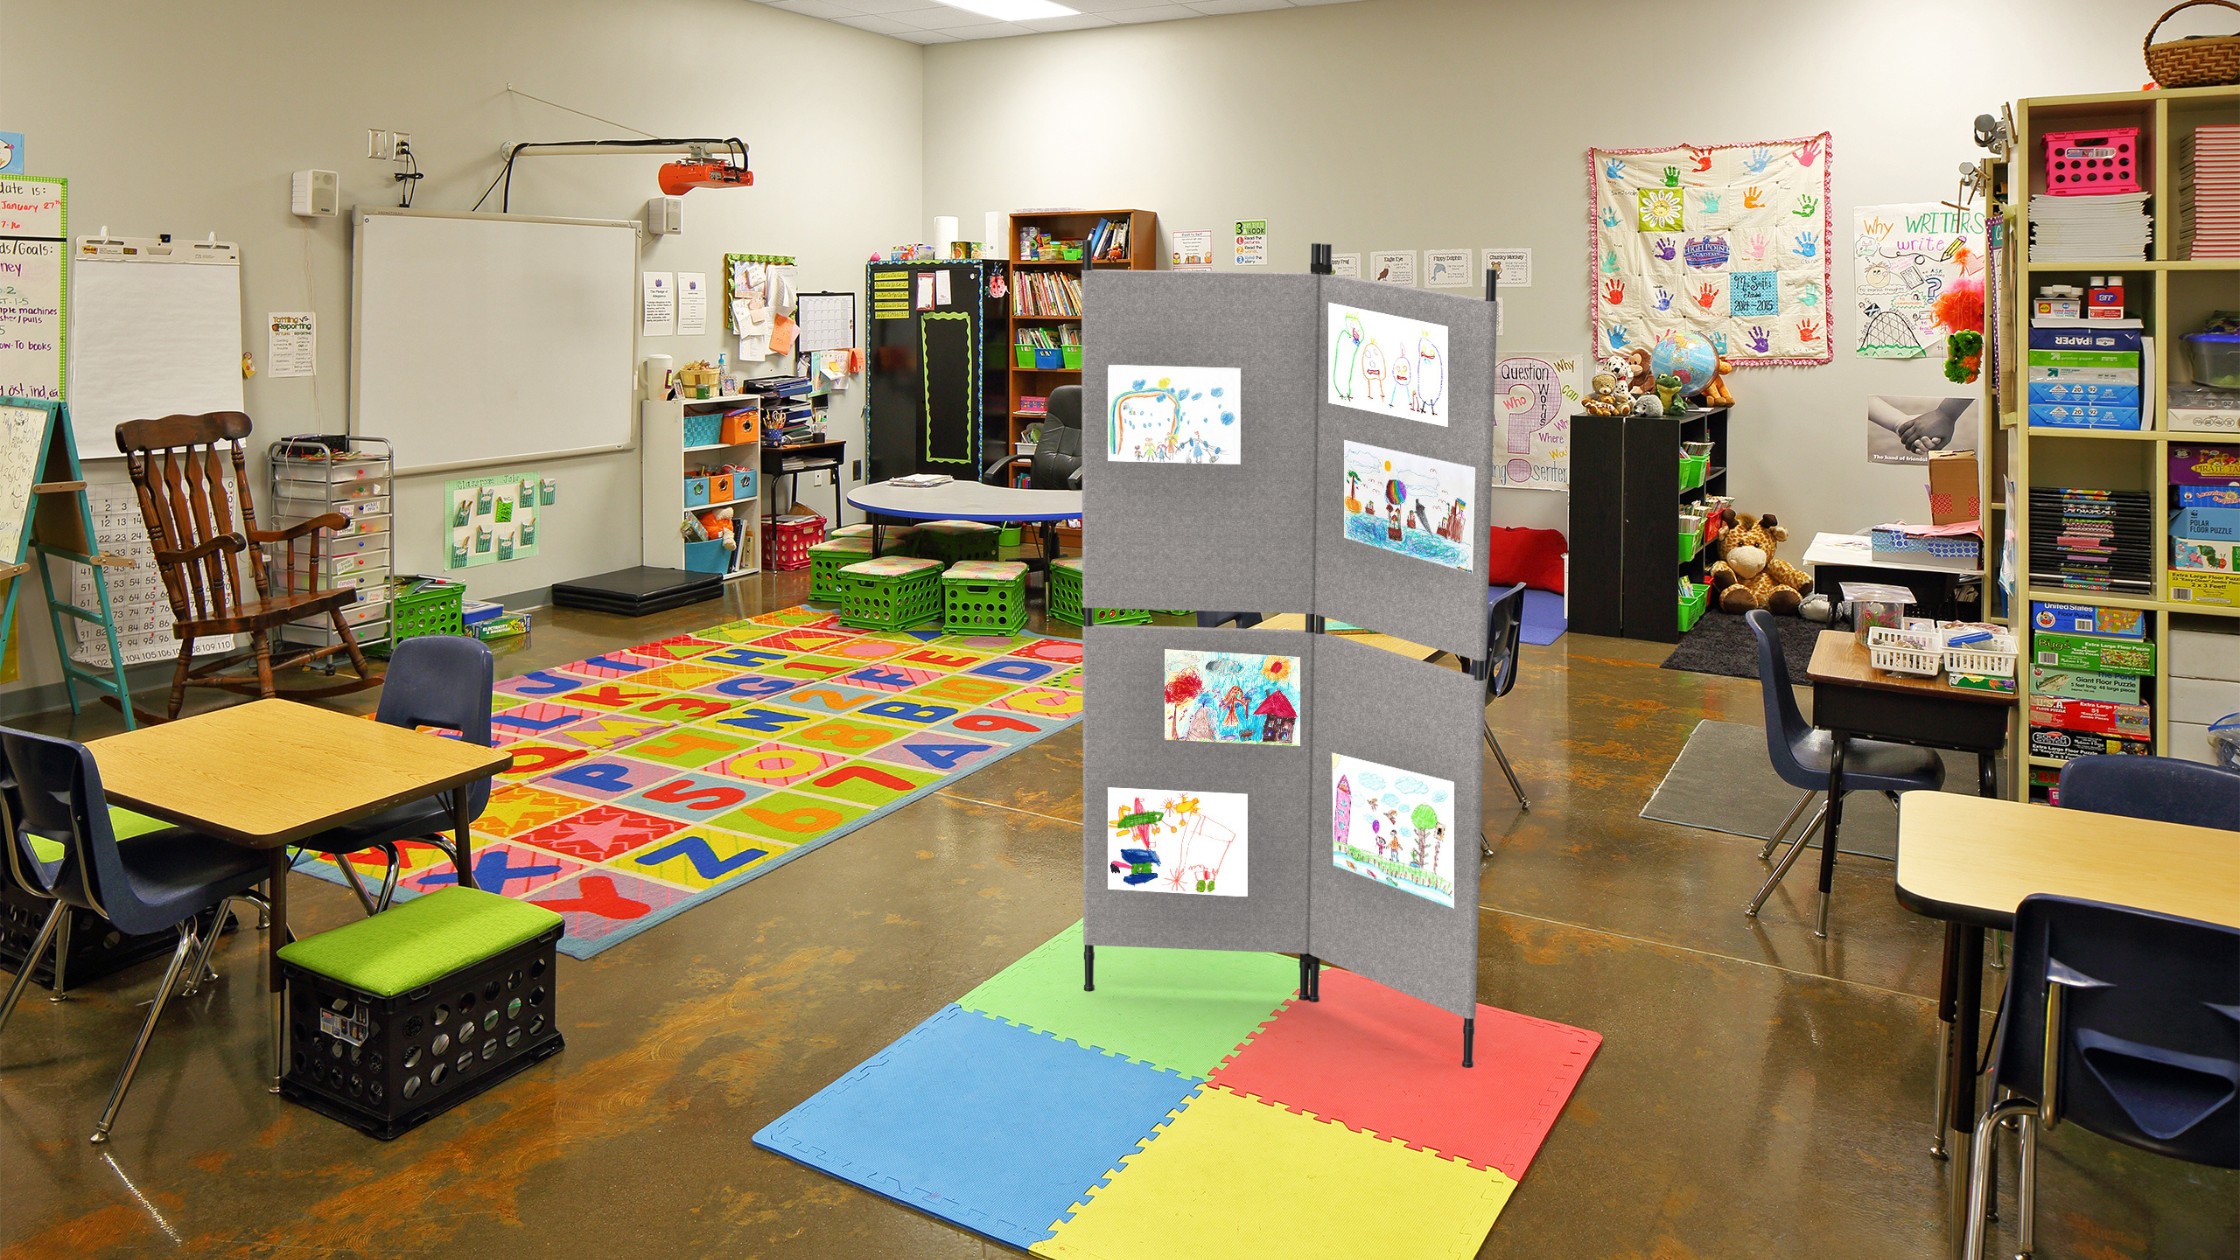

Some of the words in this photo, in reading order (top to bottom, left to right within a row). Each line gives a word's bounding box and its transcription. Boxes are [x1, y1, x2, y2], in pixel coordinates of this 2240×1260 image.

[1, 201, 38, 213] January
[1864, 216, 1894, 241] Why
[1905, 212, 1986, 235] WRITERS
[1897, 236, 1944, 251] write
[28, 341, 52, 351] books
[2055, 336, 2090, 345] PAPER
[1502, 363, 1549, 380] Question
[1554, 359, 1574, 373] Why
[1503, 396, 1526, 410] Who
[1562, 384, 1579, 402] Can
[1538, 384, 1549, 426] Words
[1539, 433, 1564, 444] Where
[113, 595, 124, 603] 63
[159, 649, 171, 657] 106
[202, 643, 215, 651] 109
[218, 641, 230, 649] 110
[2039, 639, 2071, 650] Bugs
[584, 656, 648, 672] I
[702, 648, 788, 668] H
[784, 662, 854, 675] 1
[902, 650, 980, 668] E
[848, 668, 916, 687] F
[968, 660, 1053, 682] D
[515, 671, 583, 694] J
[716, 676, 795, 697] G
[920, 678, 1010, 705] 10
[562, 686, 662, 707] K
[790, 688, 882, 710] 2
[640, 697, 732, 718] 3
[858, 701, 959, 724] B
[716, 708, 810, 732] N
[952, 714, 1042, 733] 9
[636, 734, 740, 758] 4
[800, 724, 894, 749] 8
[728, 749, 822, 779] O
[902, 743, 993, 770] A
[552, 763, 634, 792] P
[812, 766, 917, 791] 7
[642, 779, 746, 811] S
[740, 806, 843, 833] 6
[634, 835, 770, 880] Z
